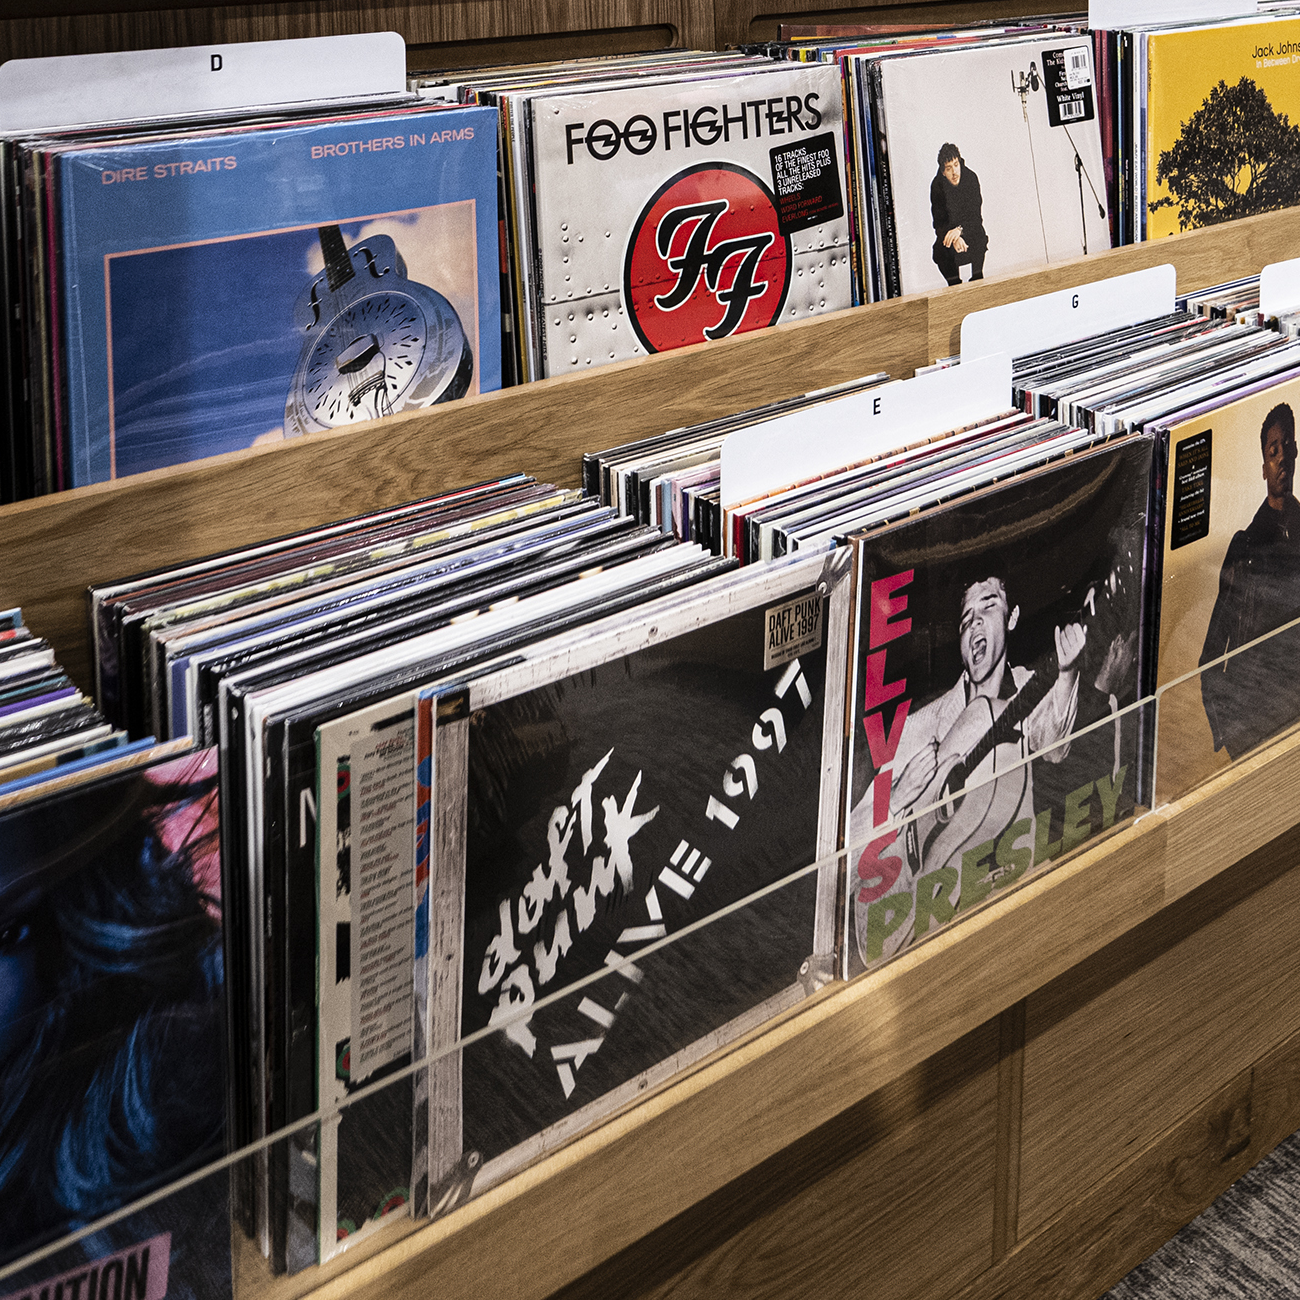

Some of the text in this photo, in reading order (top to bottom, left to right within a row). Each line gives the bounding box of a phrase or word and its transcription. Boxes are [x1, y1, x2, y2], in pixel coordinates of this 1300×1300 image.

[1252, 43, 1275, 58] Jack
[210, 54, 223, 72] D
[1256, 60, 1263, 69] In
[1263, 56, 1290, 68] Between
[565, 91, 823, 166] FOO FIGHTERS
[310, 126, 476, 160] BROTHERS IN ARMS
[774, 147, 807, 163] 16 TRACKS
[775, 148, 830, 171] OF THE FINEST FOO
[102, 156, 238, 186] DIRE STRAITS
[776, 156, 832, 180] ALL THE HITS PLUS
[777, 168, 822, 188] 3 UNRELEASED
[778, 182, 804, 196] TRACKS:
[1071, 294, 1079, 310] G
[873, 397, 882, 415] E
[769, 596, 821, 632] DAFT PUNK
[769, 622, 795, 650] ALIVE
[796, 612, 820, 638] 1997
[857, 569, 915, 903] ELVIS
[863, 765, 1130, 964] PRESLEY
[551, 658, 814, 1101] ALIVE 1997
